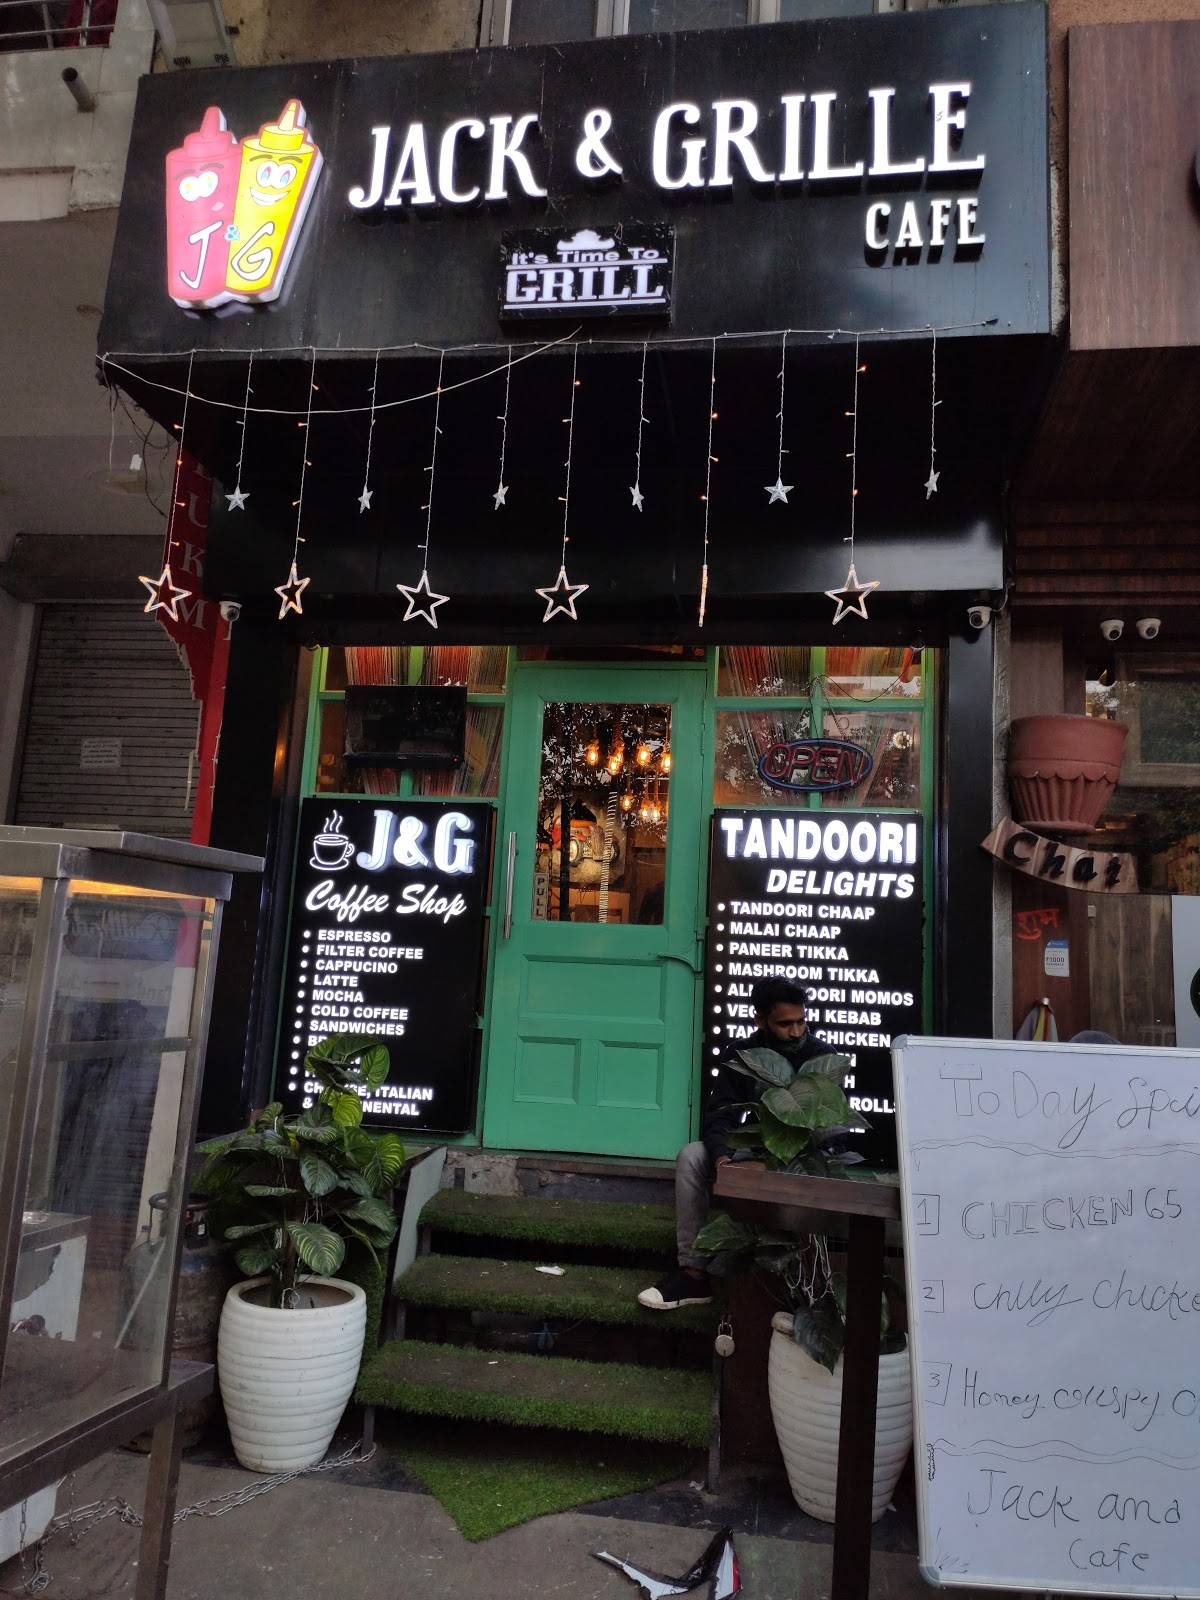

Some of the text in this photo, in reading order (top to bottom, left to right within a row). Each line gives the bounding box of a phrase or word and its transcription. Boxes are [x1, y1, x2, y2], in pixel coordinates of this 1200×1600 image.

[348, 82, 985, 208] JACK & GRILLE
[866, 198, 985, 249] CAFE
[179, 220, 224, 289] J
[230, 221, 275, 281] G
[511, 247, 659, 265] It's Time To
[506, 265, 664, 303] GRILL
[764, 743, 868, 785] OPEN
[356, 810, 475, 875] J&G
[720, 817, 917, 864] TANDOORI
[767, 869, 915, 898] DELIGHTS
[305, 879, 467, 924] Coffee Shop
[536, 877, 545, 917] PULL
[730, 901, 875, 920] TANDOORI CHAAP
[317, 929, 392, 944] ESPRESSO
[730, 921, 841, 939] MALAI CHAAP
[316, 944, 424, 960] FILTER COFFEE
[729, 941, 849, 961] PANEER TIKKA
[315, 959, 398, 974] CAPPUCINO
[728, 962, 880, 983] MASHROOM TIKKA
[313, 974, 358, 987] LATTE
[312, 989, 364, 1003] MOCHA
[851, 989, 914, 1007] MOMOS
[311, 1004, 409, 1020] COLD COFFEE
[825, 1009, 882, 1025] KEBAB
[309, 1020, 405, 1036] SANDWICHES
[816, 1029, 891, 1048] CHICKEN
[302, 1096, 313, 1109] &
[849, 1096, 896, 1114] ROLL
[962, 1189, 1133, 1239] CHICKEN
[1145, 1187, 1182, 1220] 65
